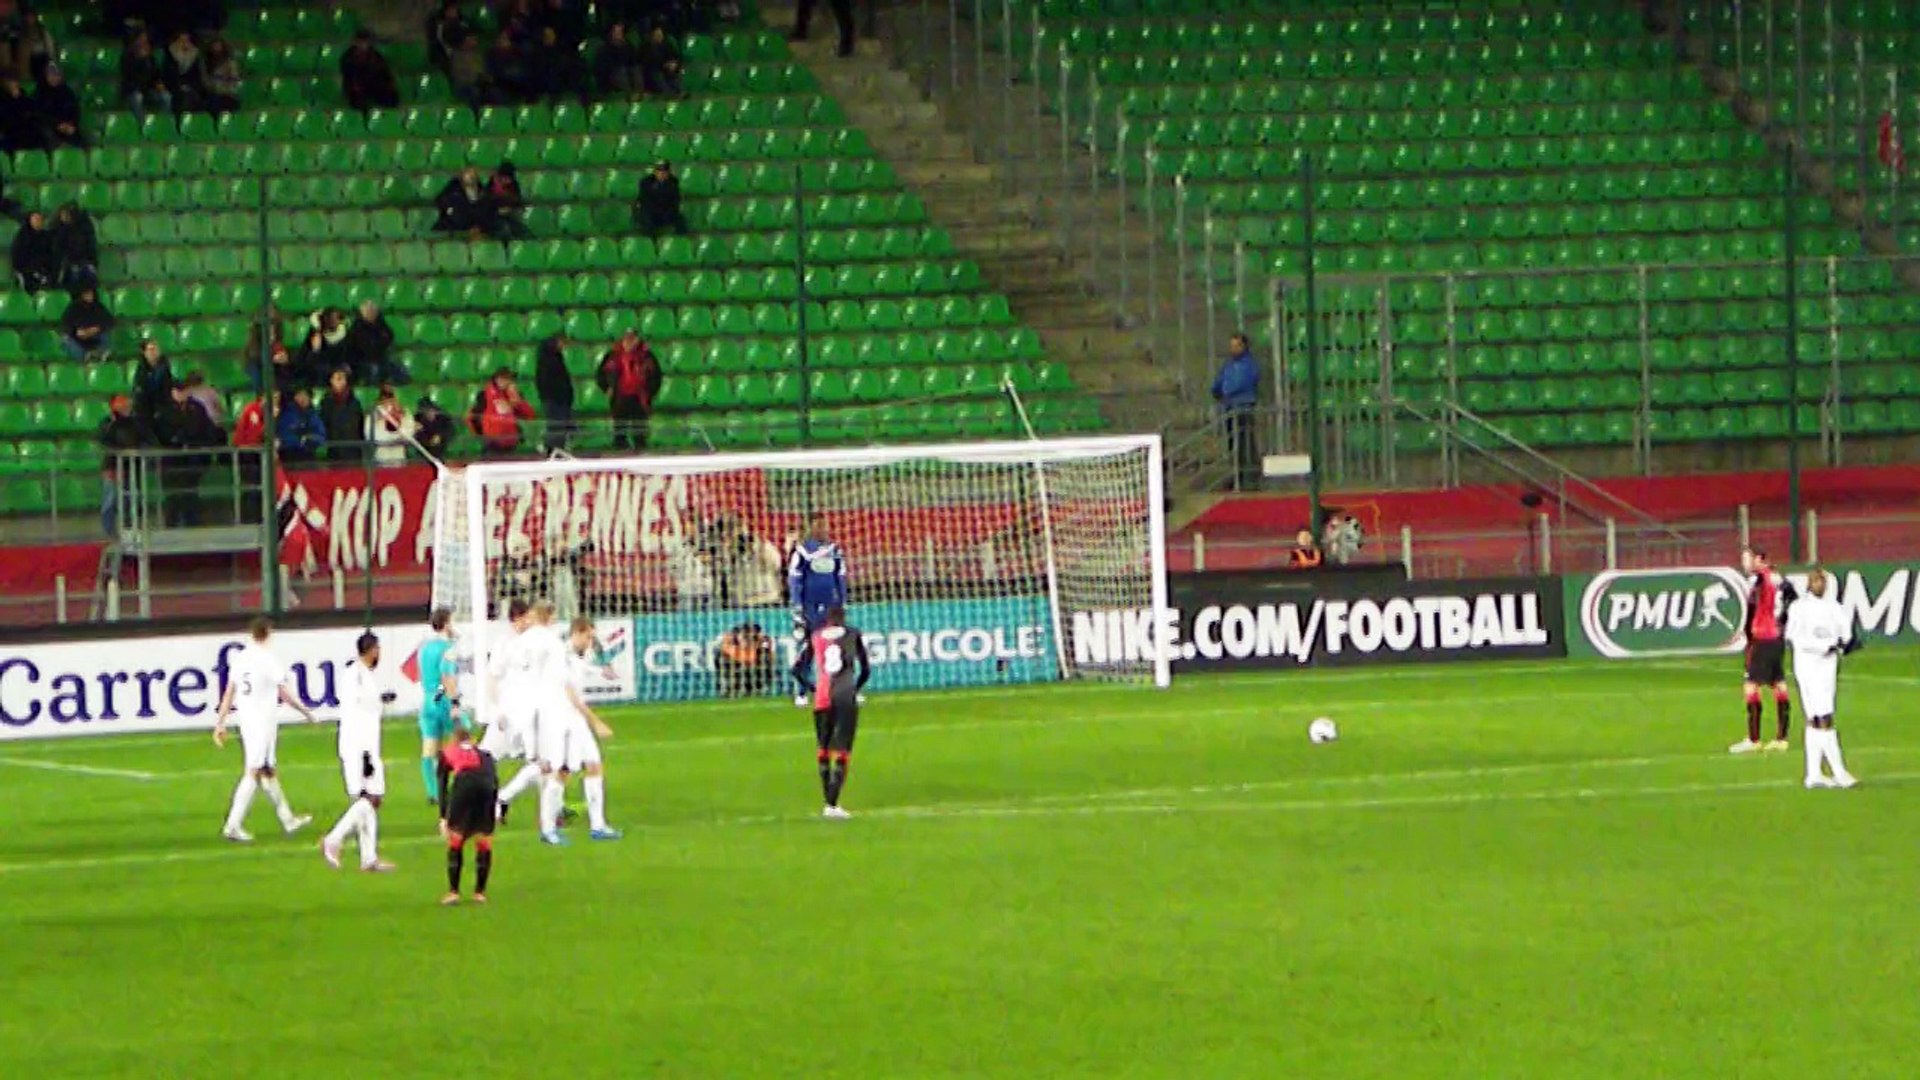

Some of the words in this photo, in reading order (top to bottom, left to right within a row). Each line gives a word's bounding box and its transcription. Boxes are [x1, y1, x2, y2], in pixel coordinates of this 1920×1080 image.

[329, 484, 403, 571] KOP
[415, 477, 534, 564] AEZ
[544, 472, 687, 558] RENNES
[1073, 593, 1547, 663] NIKE.COM/FOOTBALL
[1608, 590, 1697, 632] PMU
[1784, 568, 1920, 636] PM
[0, 641, 355, 726] Carrefu
[644, 630, 800, 675] CRT
[861, 625, 1045, 664] GRICOLE
[825, 643, 843, 673] 8
